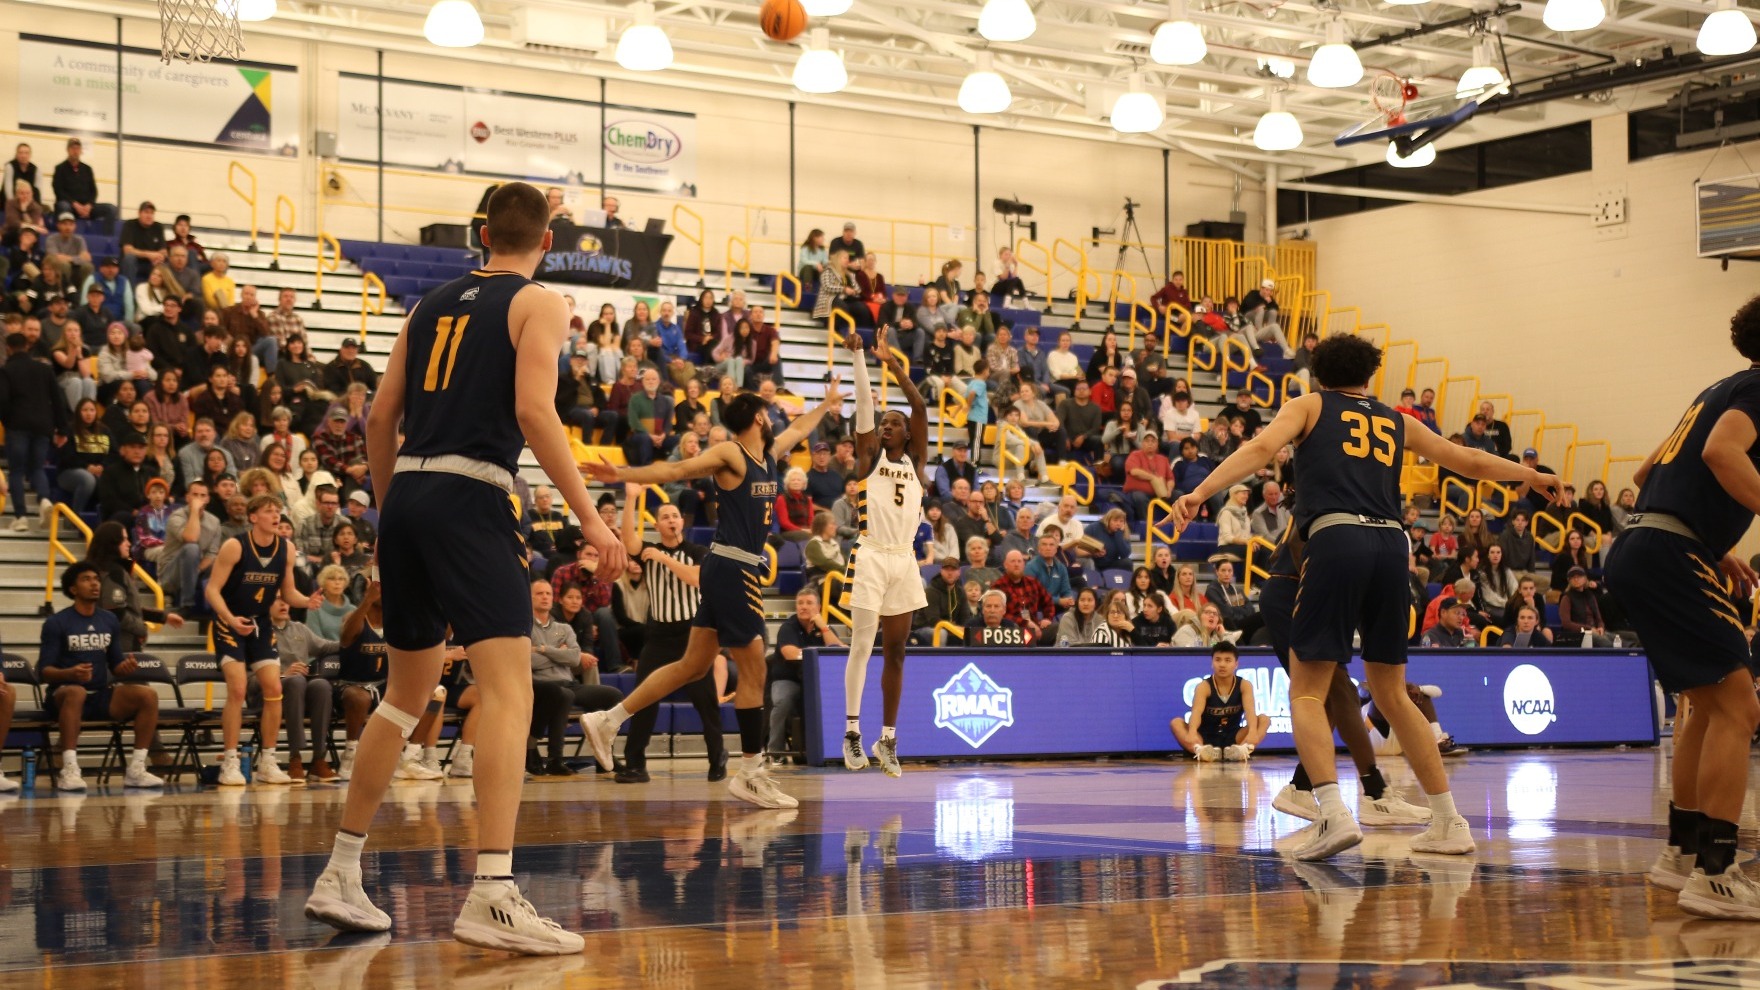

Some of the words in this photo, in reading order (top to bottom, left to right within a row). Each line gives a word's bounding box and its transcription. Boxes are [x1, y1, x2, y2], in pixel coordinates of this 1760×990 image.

[54, 55, 64, 68] A
[148, 68, 162, 80] of
[165, 71, 229, 88] caregivers
[53, 76, 70, 87] on
[74, 78, 82, 88] a
[86, 79, 140, 94] misson.
[494, 125, 514, 138] Best
[515, 127, 552, 140] Western
[554, 131, 578, 143] PLUS
[545, 251, 632, 280] SKYHAWKS
[423, 315, 470, 391] 11
[1341, 410, 1396, 467] 35
[894, 484, 905, 507] 5
[254, 587, 265, 604] 4
[68, 633, 111, 649] REGIS
[983, 628, 1024, 645] POSS.
[940, 694, 1007, 720] RMAC
[1512, 699, 1552, 715] NCAA
